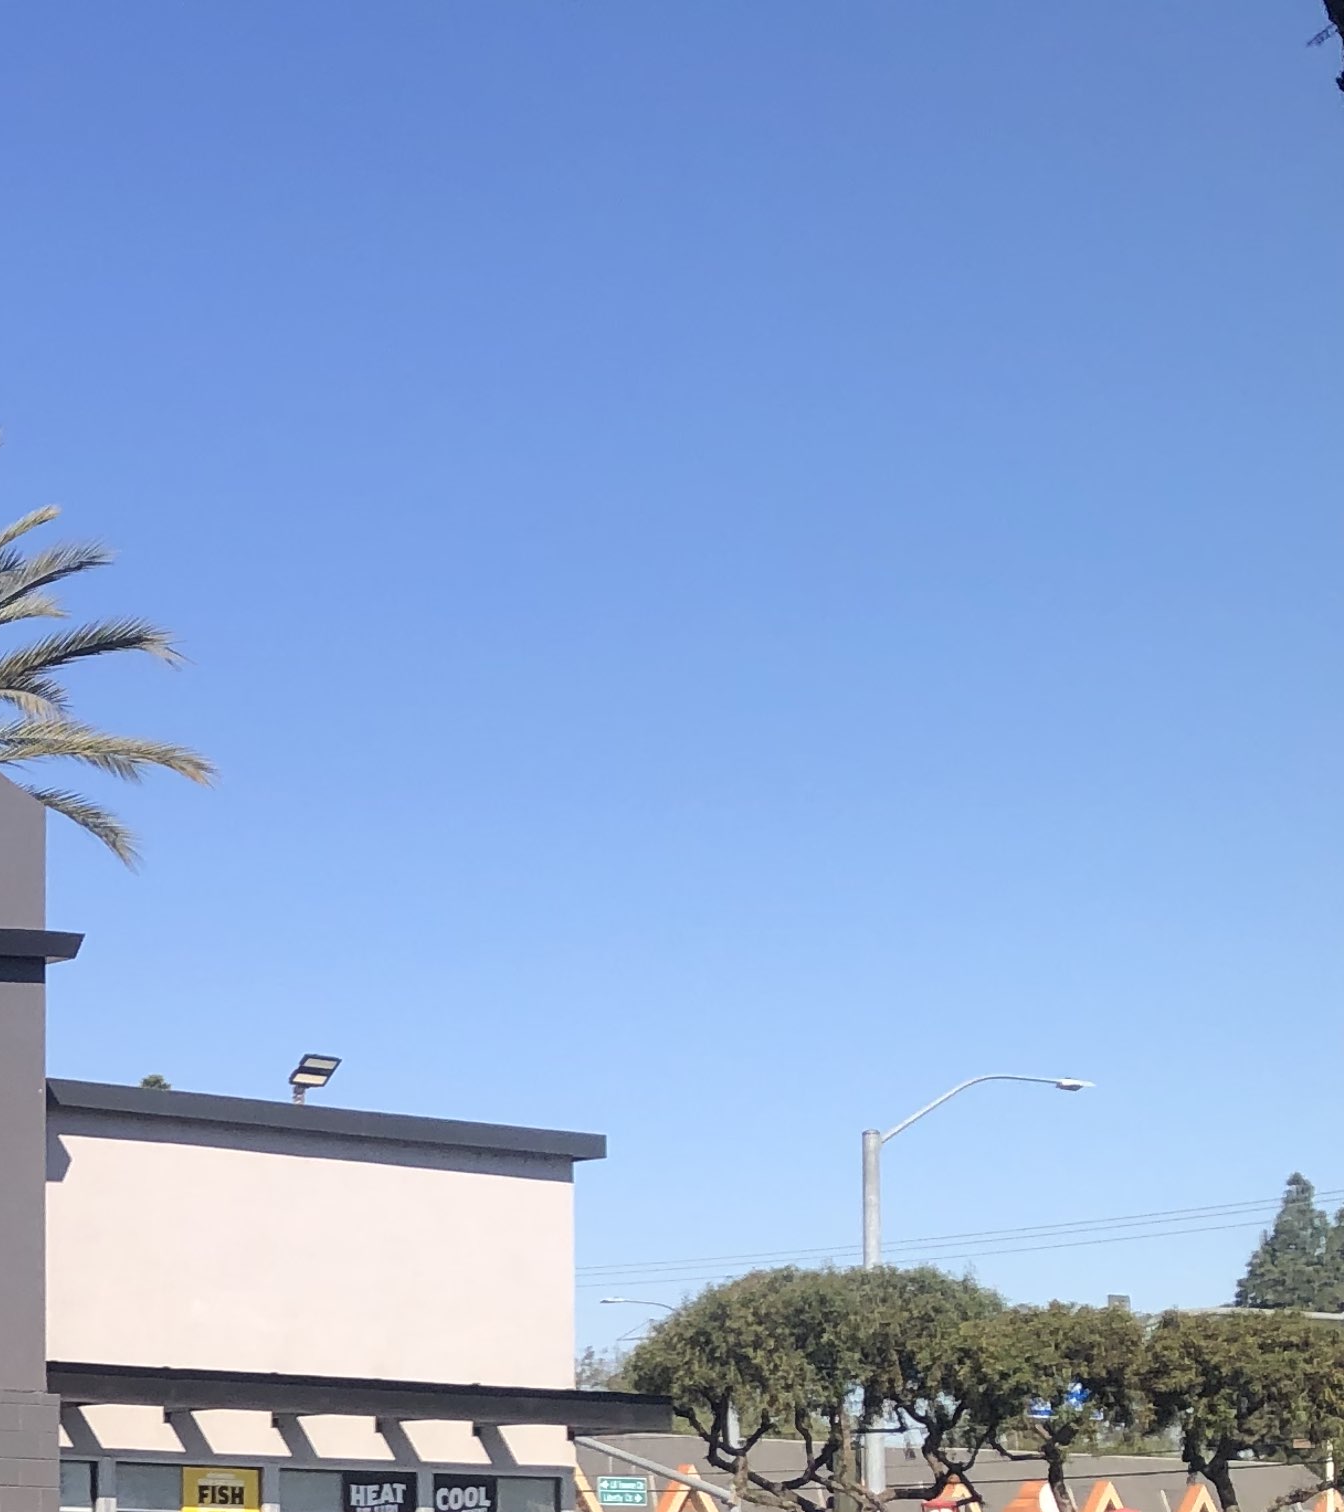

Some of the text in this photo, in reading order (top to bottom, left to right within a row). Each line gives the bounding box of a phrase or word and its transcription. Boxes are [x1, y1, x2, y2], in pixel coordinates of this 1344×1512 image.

[198, 1485, 244, 1505] FISH
[350, 1483, 407, 1506] HEAT
[436, 1486, 491, 1511] COOL
